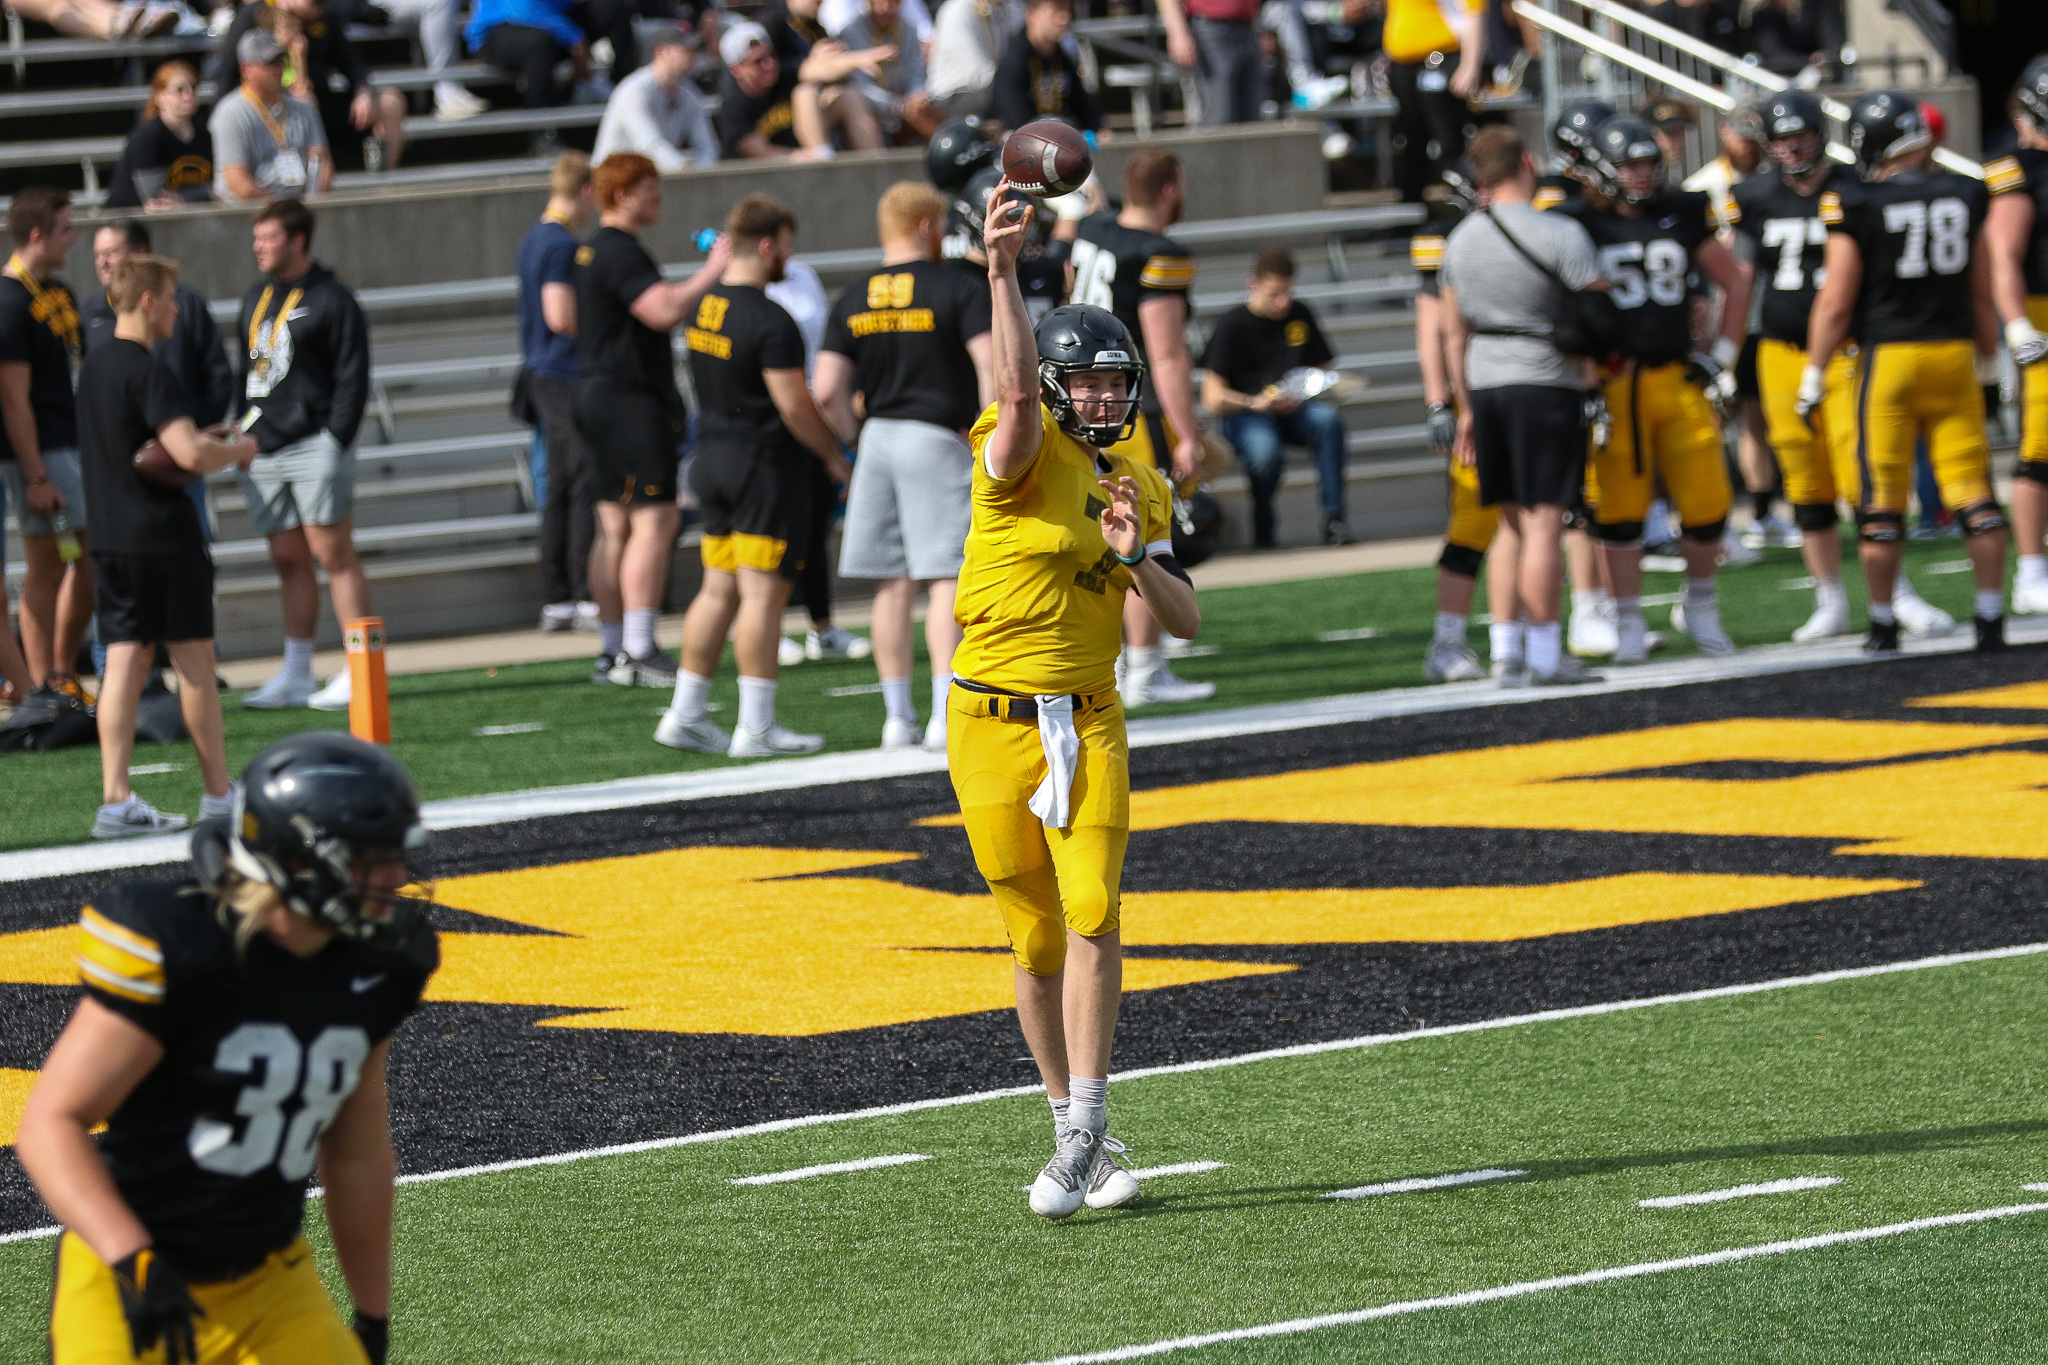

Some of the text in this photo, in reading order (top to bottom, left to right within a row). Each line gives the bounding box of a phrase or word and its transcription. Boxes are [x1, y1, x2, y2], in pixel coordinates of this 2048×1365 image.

[1071, 238, 1117, 313] 76
[1599, 238, 1687, 310] 58
[1882, 197, 1970, 278] 78
[187, 1021, 372, 1182] 38
